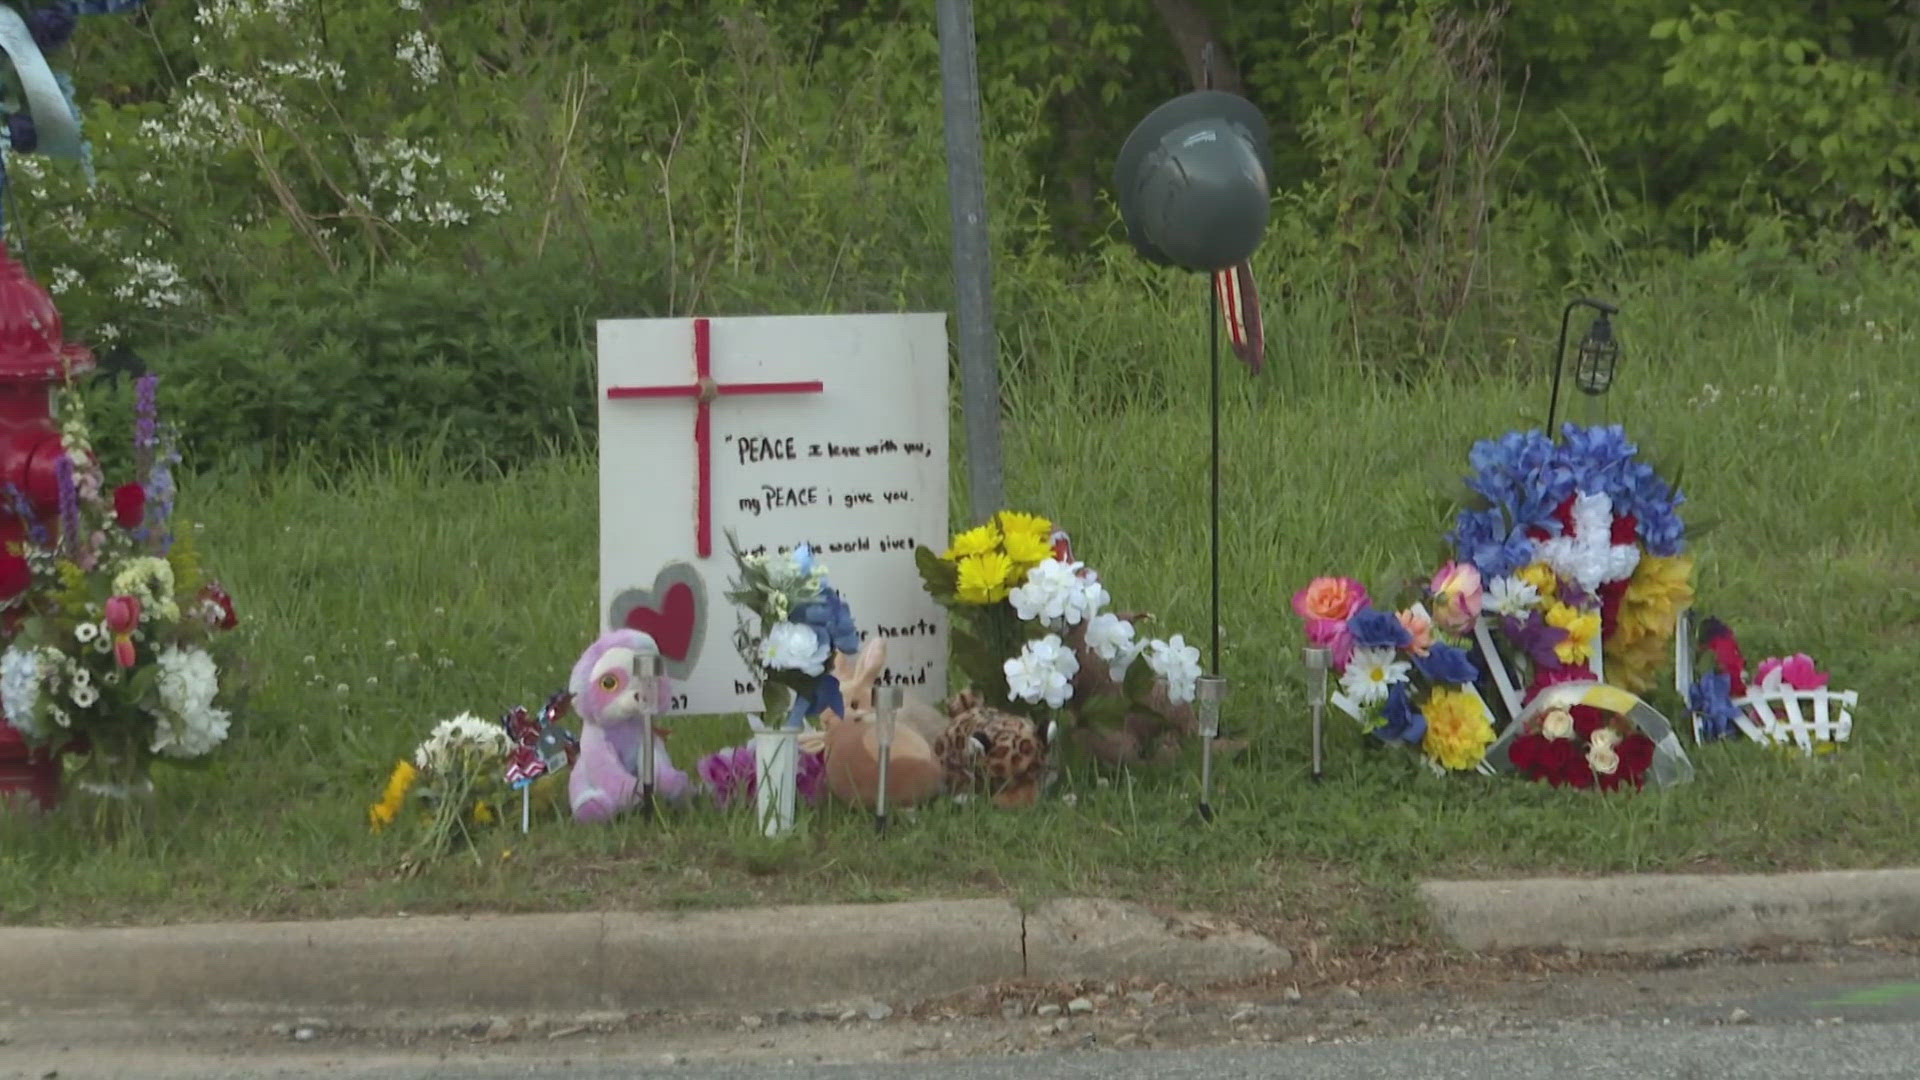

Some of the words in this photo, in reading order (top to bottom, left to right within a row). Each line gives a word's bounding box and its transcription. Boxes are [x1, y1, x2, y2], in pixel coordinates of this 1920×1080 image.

[866, 440, 898, 455] with
[738, 497, 761, 516] my
[761, 484, 818, 511] PEACE
[844, 489, 874, 508] give
[829, 537, 870, 553] world
[878, 618, 937, 638] hearts
